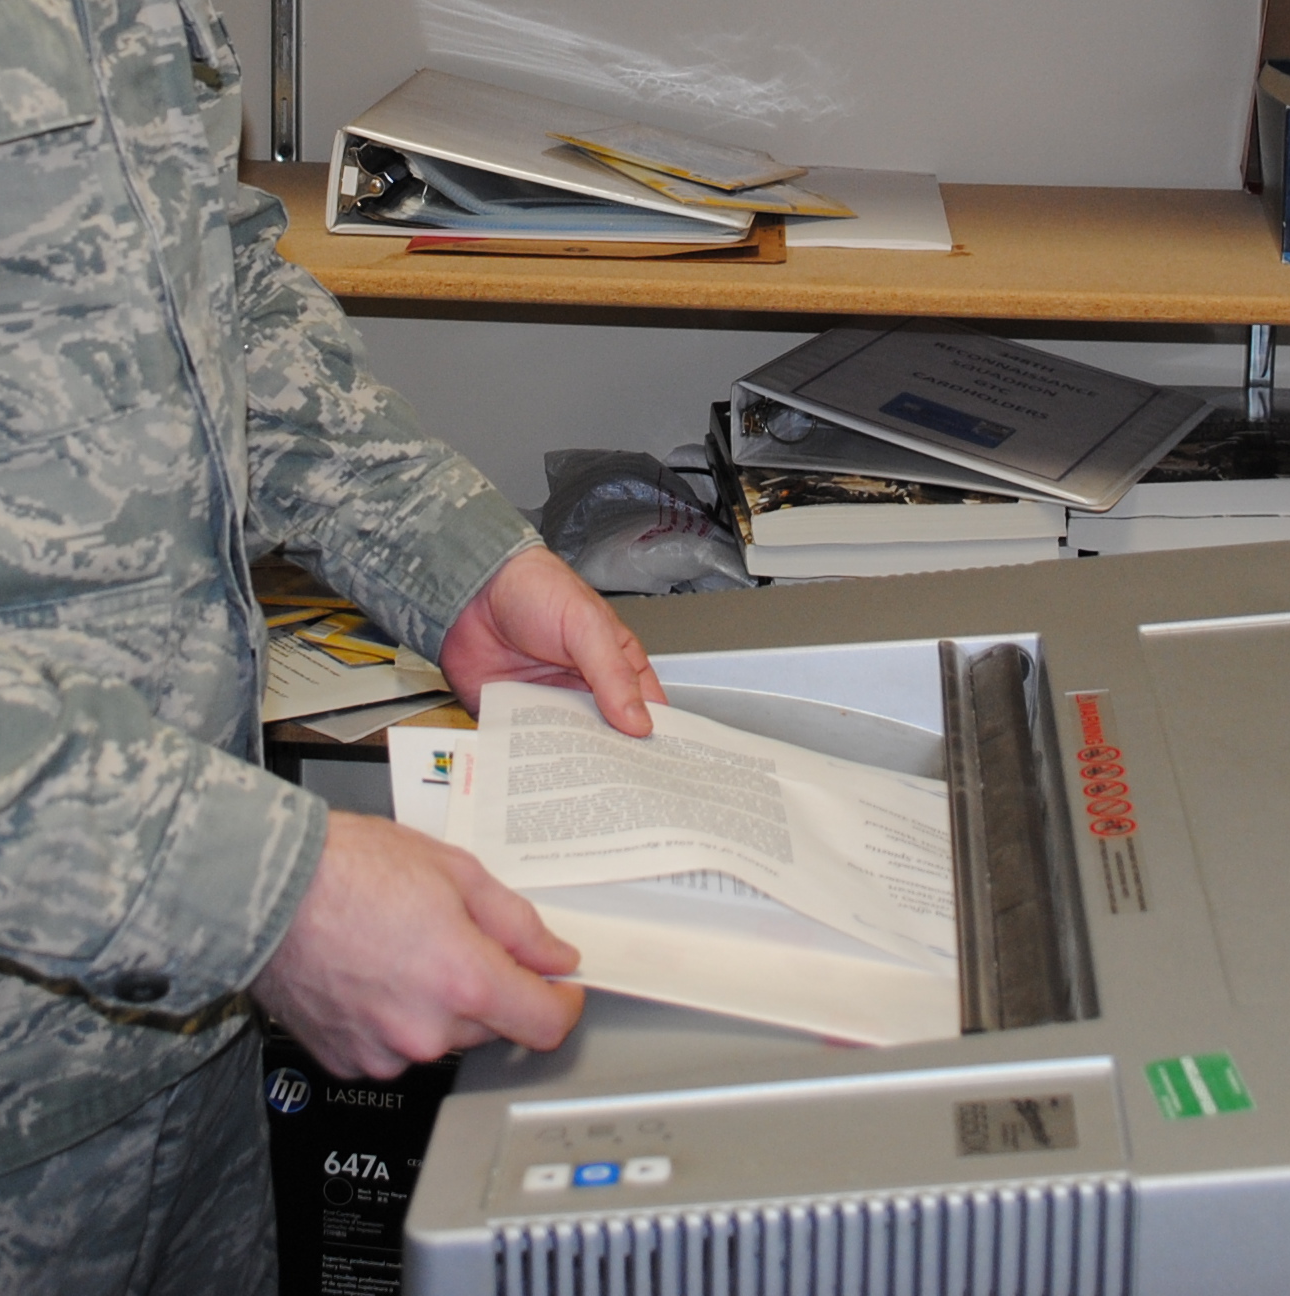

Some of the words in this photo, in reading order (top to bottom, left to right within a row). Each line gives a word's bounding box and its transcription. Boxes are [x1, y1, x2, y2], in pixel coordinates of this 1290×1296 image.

[934, 341, 1100, 398] RECONNAISSANCE
[951, 359, 1057, 397] SQUADRON
[973, 379, 1010, 395] GTC
[912, 371, 1049, 420] CARDHOLDERS
[268, 1067, 308, 1113] hp
[326, 1087, 404, 1109] LASERJET
[323, 1151, 390, 1181] 647A
